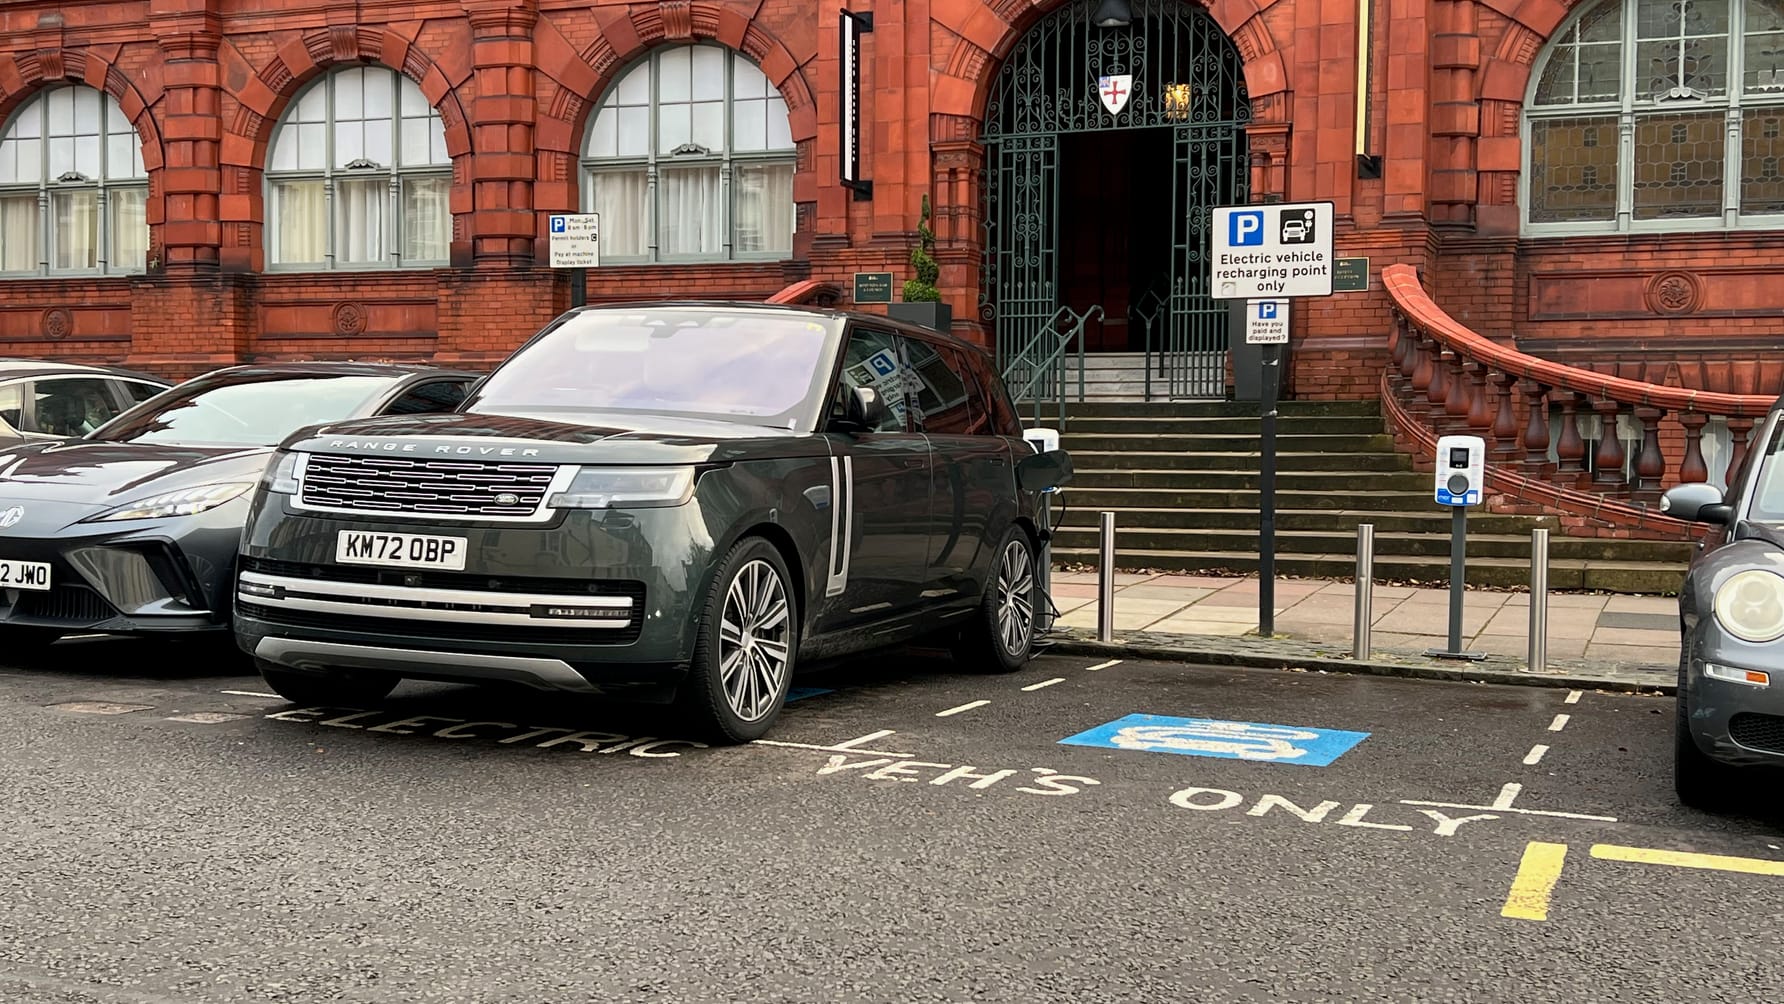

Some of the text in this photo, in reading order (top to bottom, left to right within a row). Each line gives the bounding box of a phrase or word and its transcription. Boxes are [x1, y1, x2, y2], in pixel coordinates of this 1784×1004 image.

[553, 218, 564, 232] P
[1236, 214, 1259, 244] P
[1220, 251, 1323, 265] Electric vehicle
[1216, 266, 1287, 282] recharging
[1292, 264, 1327, 278] point
[1257, 280, 1286, 293] only
[1263, 304, 1275, 318] P
[330, 440, 540, 456] RANGE ROVER
[346, 533, 456, 562] KM72 OBP
[0, 563, 47, 585] 2 JWO
[264, 706, 1501, 837] ELECTRIC VEH'S ONLY
